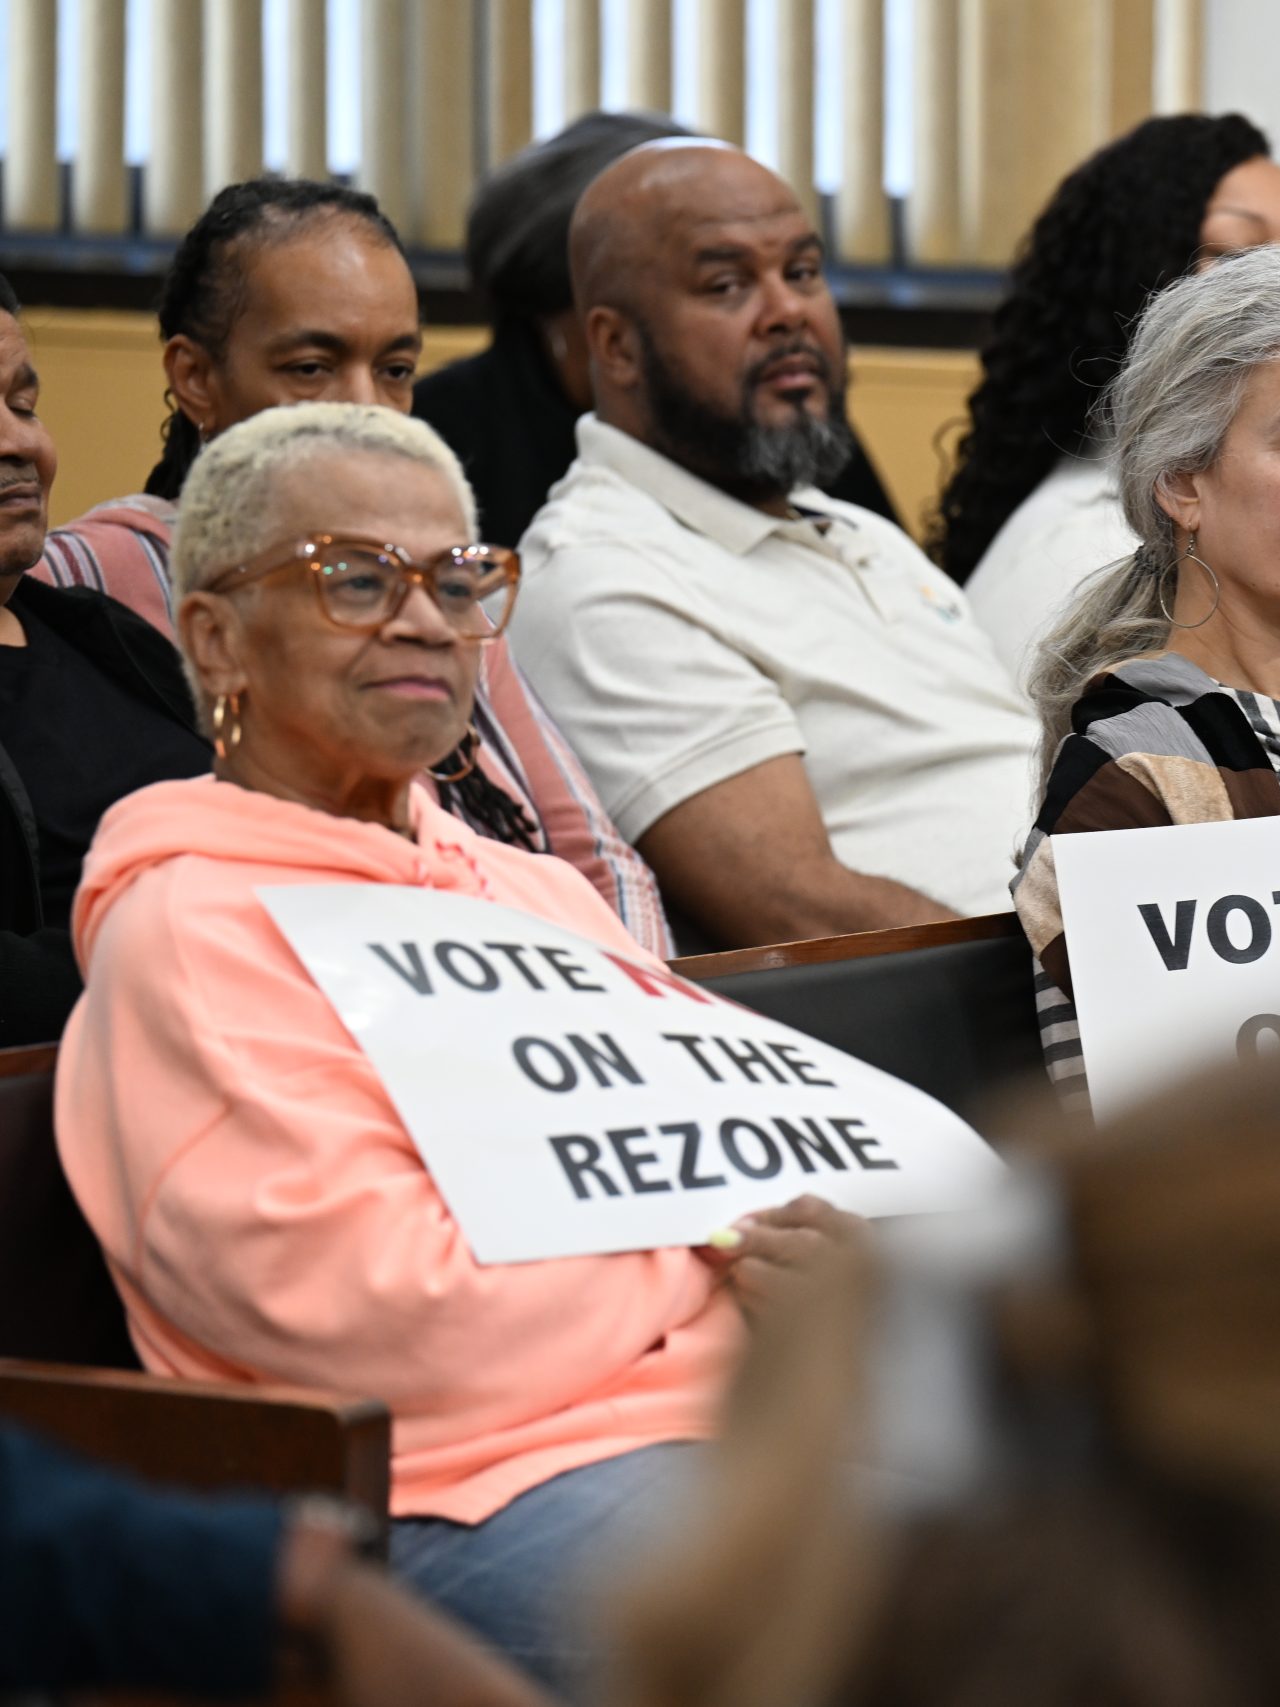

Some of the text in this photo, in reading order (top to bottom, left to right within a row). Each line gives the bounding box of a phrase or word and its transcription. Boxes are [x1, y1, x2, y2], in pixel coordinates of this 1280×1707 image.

[367, 940, 767, 1018] VOTE N
[512, 1033, 836, 1092] ON THE
[548, 1117, 900, 1199] REZONE
